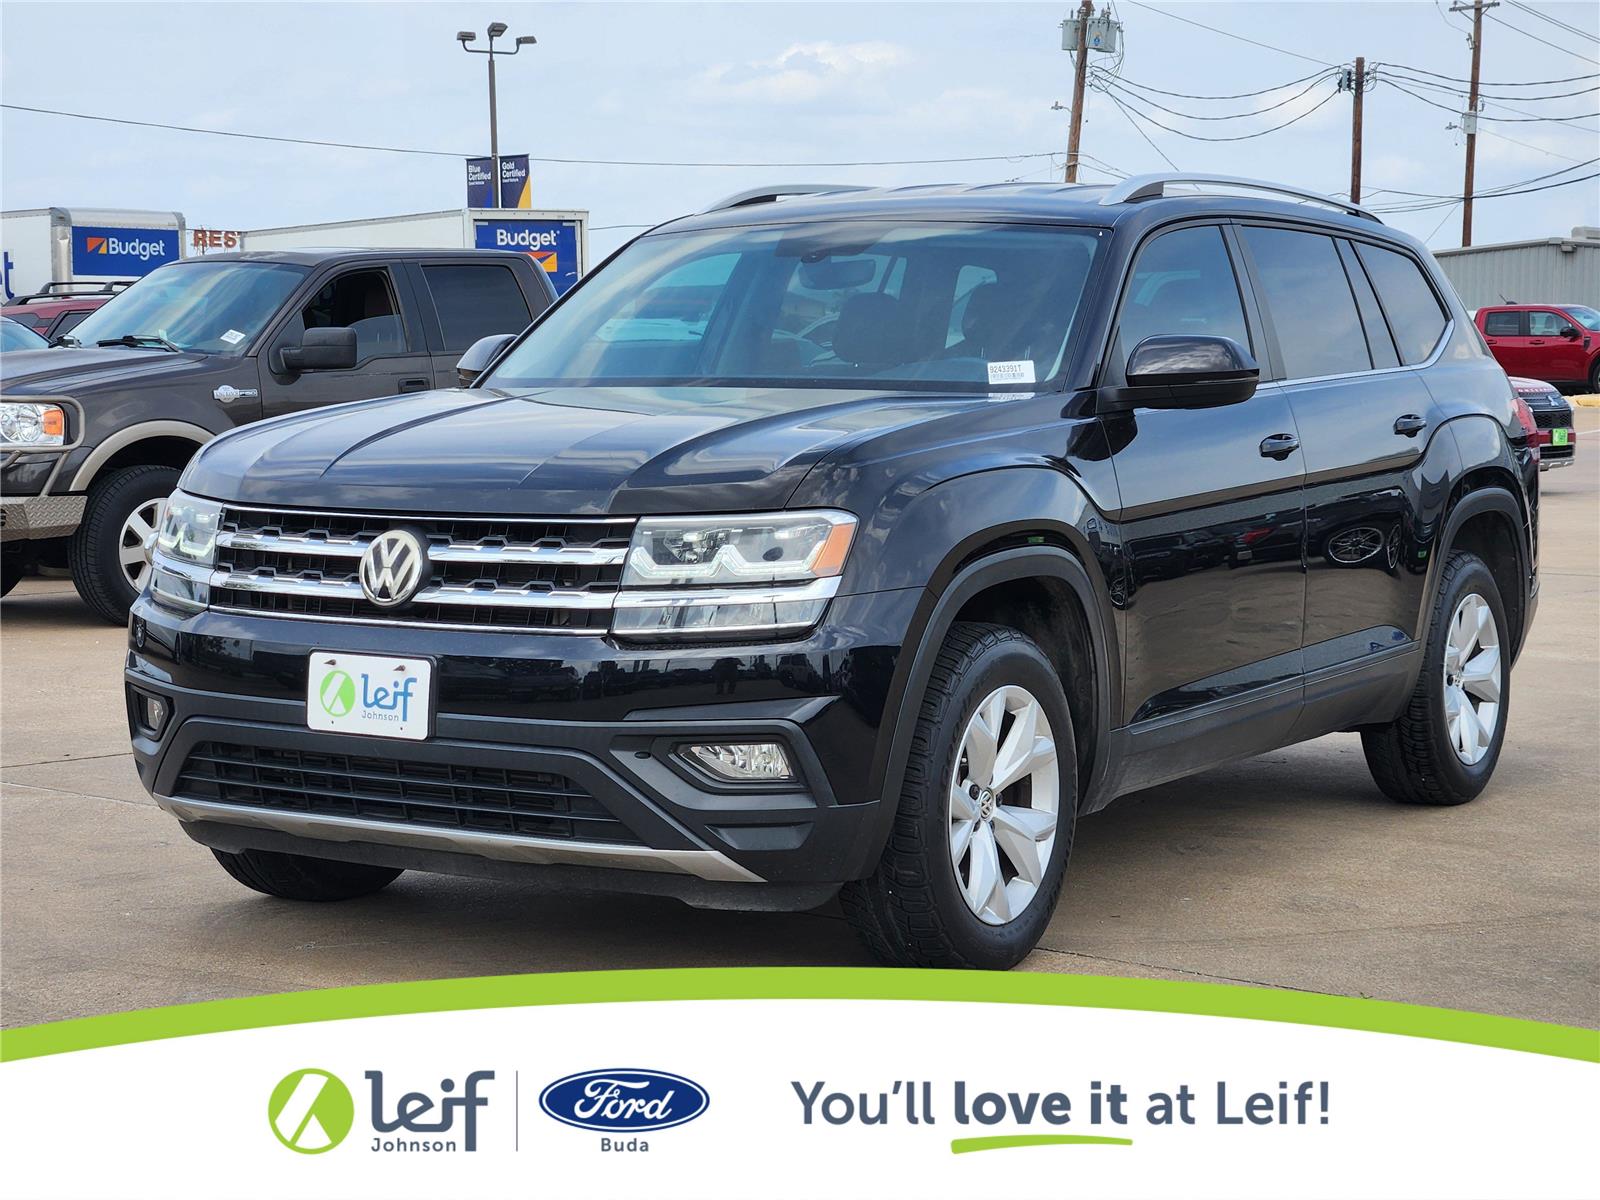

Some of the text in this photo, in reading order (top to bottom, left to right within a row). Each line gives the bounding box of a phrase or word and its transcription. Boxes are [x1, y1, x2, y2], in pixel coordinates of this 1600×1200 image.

[468, 165, 481, 173] Blue
[502, 162, 515, 170] Gold
[468, 172, 491, 181] Certified
[502, 169, 525, 178] Certified
[193, 230, 241, 248] RES
[496, 229, 556, 250] Budget
[109, 237, 165, 260] Budget
[361, 673, 417, 722] leif
[361, 710, 399, 722] Johnson
